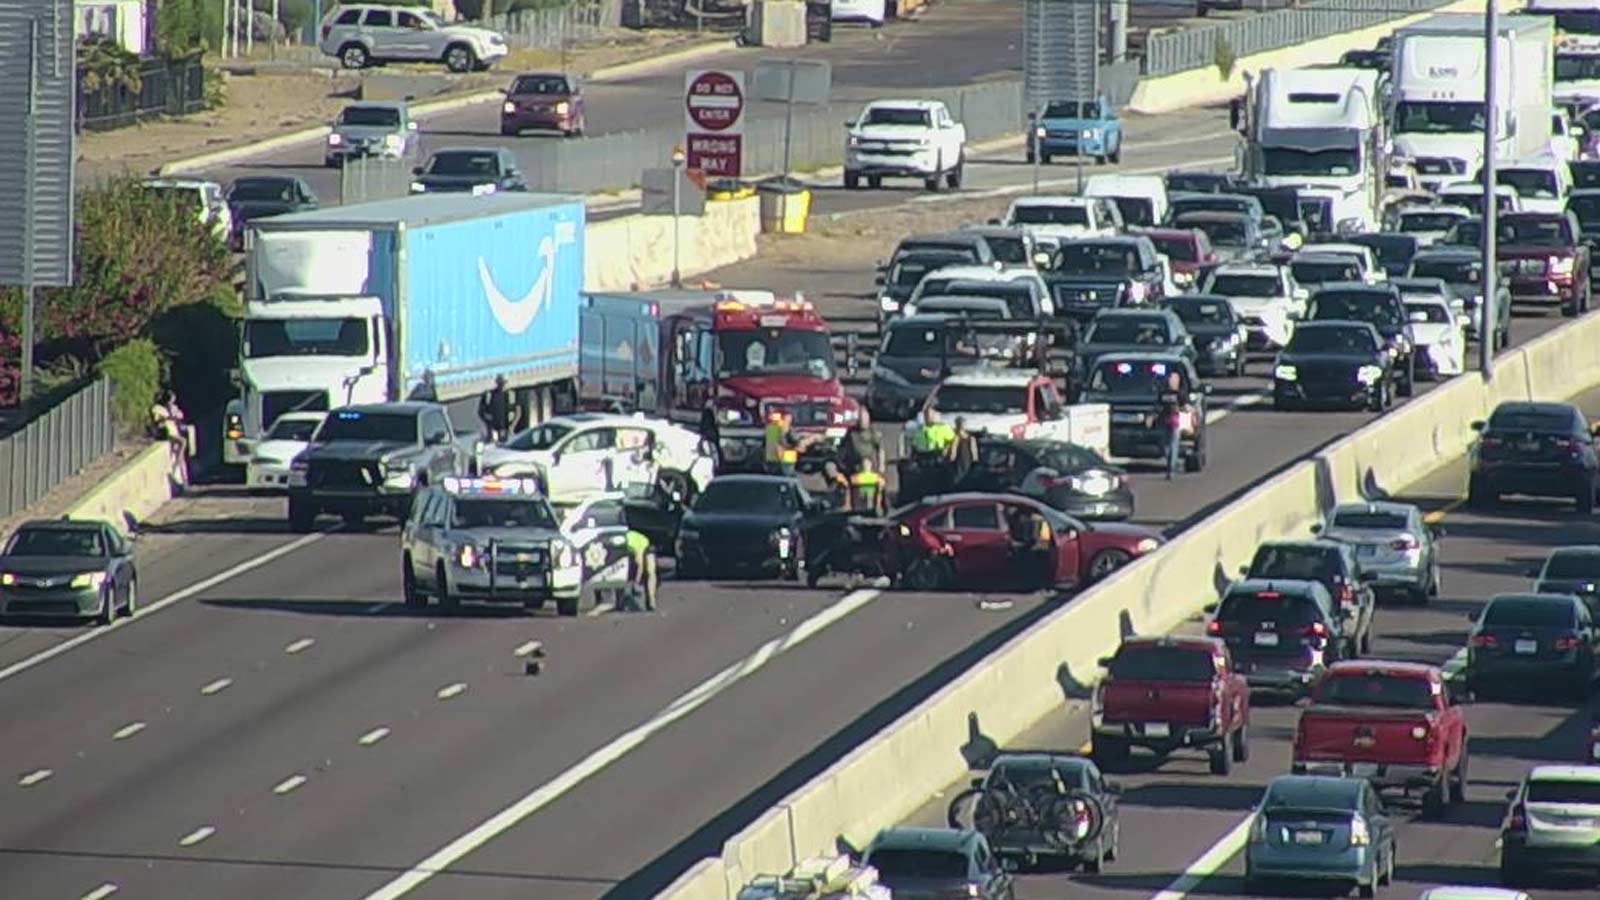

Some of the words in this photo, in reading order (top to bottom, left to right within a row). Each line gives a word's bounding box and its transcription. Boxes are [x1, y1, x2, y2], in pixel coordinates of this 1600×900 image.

[695, 83, 711, 94] DO
[691, 139, 737, 153] WRONG
[700, 158, 728, 170] WAY
